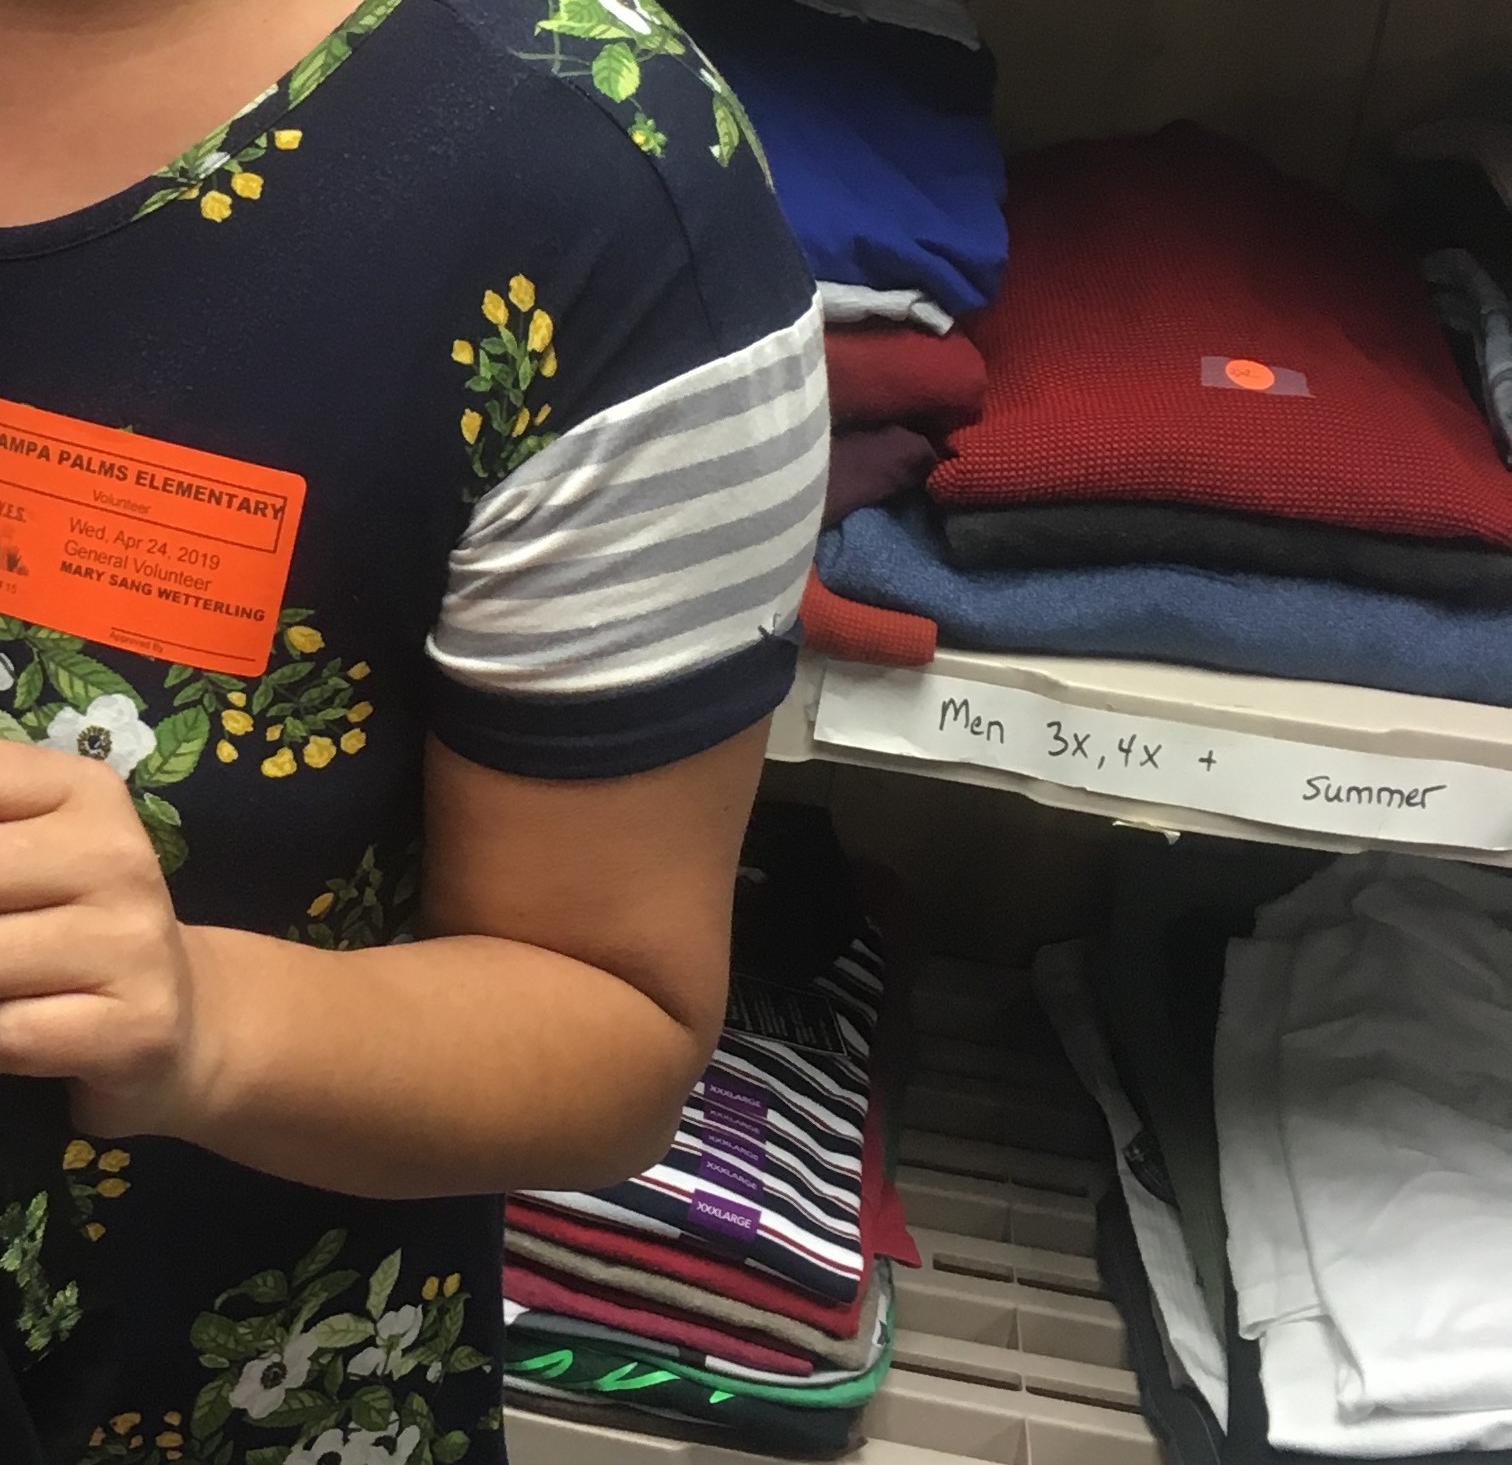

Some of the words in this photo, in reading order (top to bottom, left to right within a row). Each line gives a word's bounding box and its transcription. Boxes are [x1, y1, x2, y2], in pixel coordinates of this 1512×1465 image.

[57, 449, 129, 482] PALMS
[134, 469, 286, 521] ELEMENTARY
[92, 488, 152, 515] Volunteer
[64, 539, 129, 570] General
[133, 557, 213, 592] Volunteer
[68, 517, 109, 544] Wed,
[113, 530, 141, 551] Apr
[146, 538, 172, 561] 24,
[177, 546, 221, 571] 2019
[59, 560, 106, 582] MARY
[108, 573, 153, 596] SANG
[156, 587, 266, 622] WETTERLING
[938, 698, 1005, 744] Men
[709, 1084, 762, 1109] XXXLARGE
[706, 1160, 758, 1190] XXXLARGE
[695, 1199, 753, 1230] XXXLARGE
